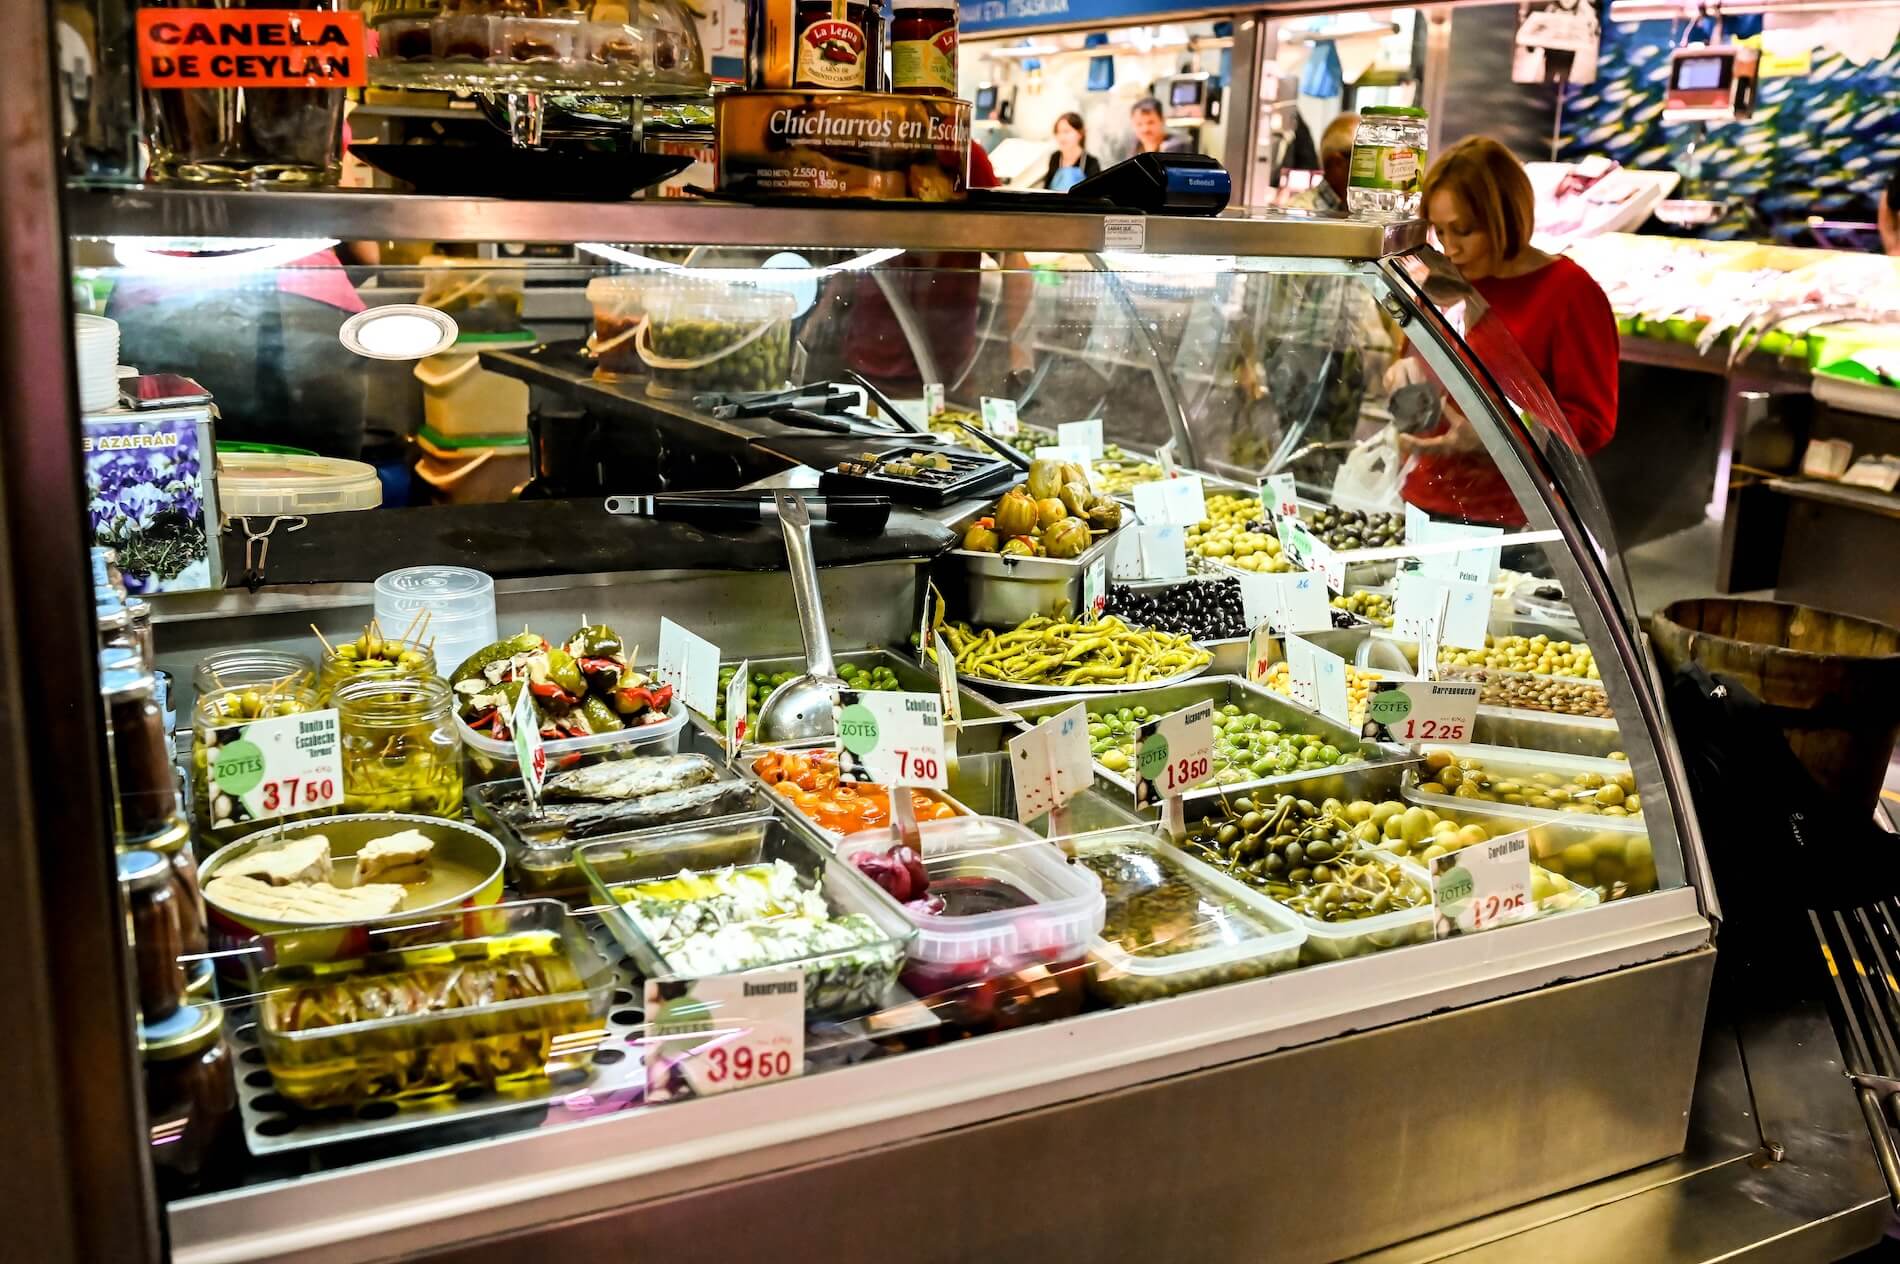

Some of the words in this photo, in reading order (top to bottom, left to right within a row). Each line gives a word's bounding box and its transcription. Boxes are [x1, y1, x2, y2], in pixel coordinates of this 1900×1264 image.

[149, 22, 349, 46] CANELA
[814, 28, 827, 40] La
[830, 24, 857, 43] Legua
[152, 55, 199, 78] DE
[210, 55, 349, 78] CEYLAN
[769, 109, 893, 139] Chicharros
[898, 120, 922, 139] en
[100, 432, 176, 449] AZAFRÁN
[1373, 703, 1409, 712] ZOTES
[842, 724, 877, 736] ZOTES
[1141, 749, 1167, 767] ZOTES
[218, 759, 262, 778] ZOTES
[1440, 883, 1473, 903] ZOTES
